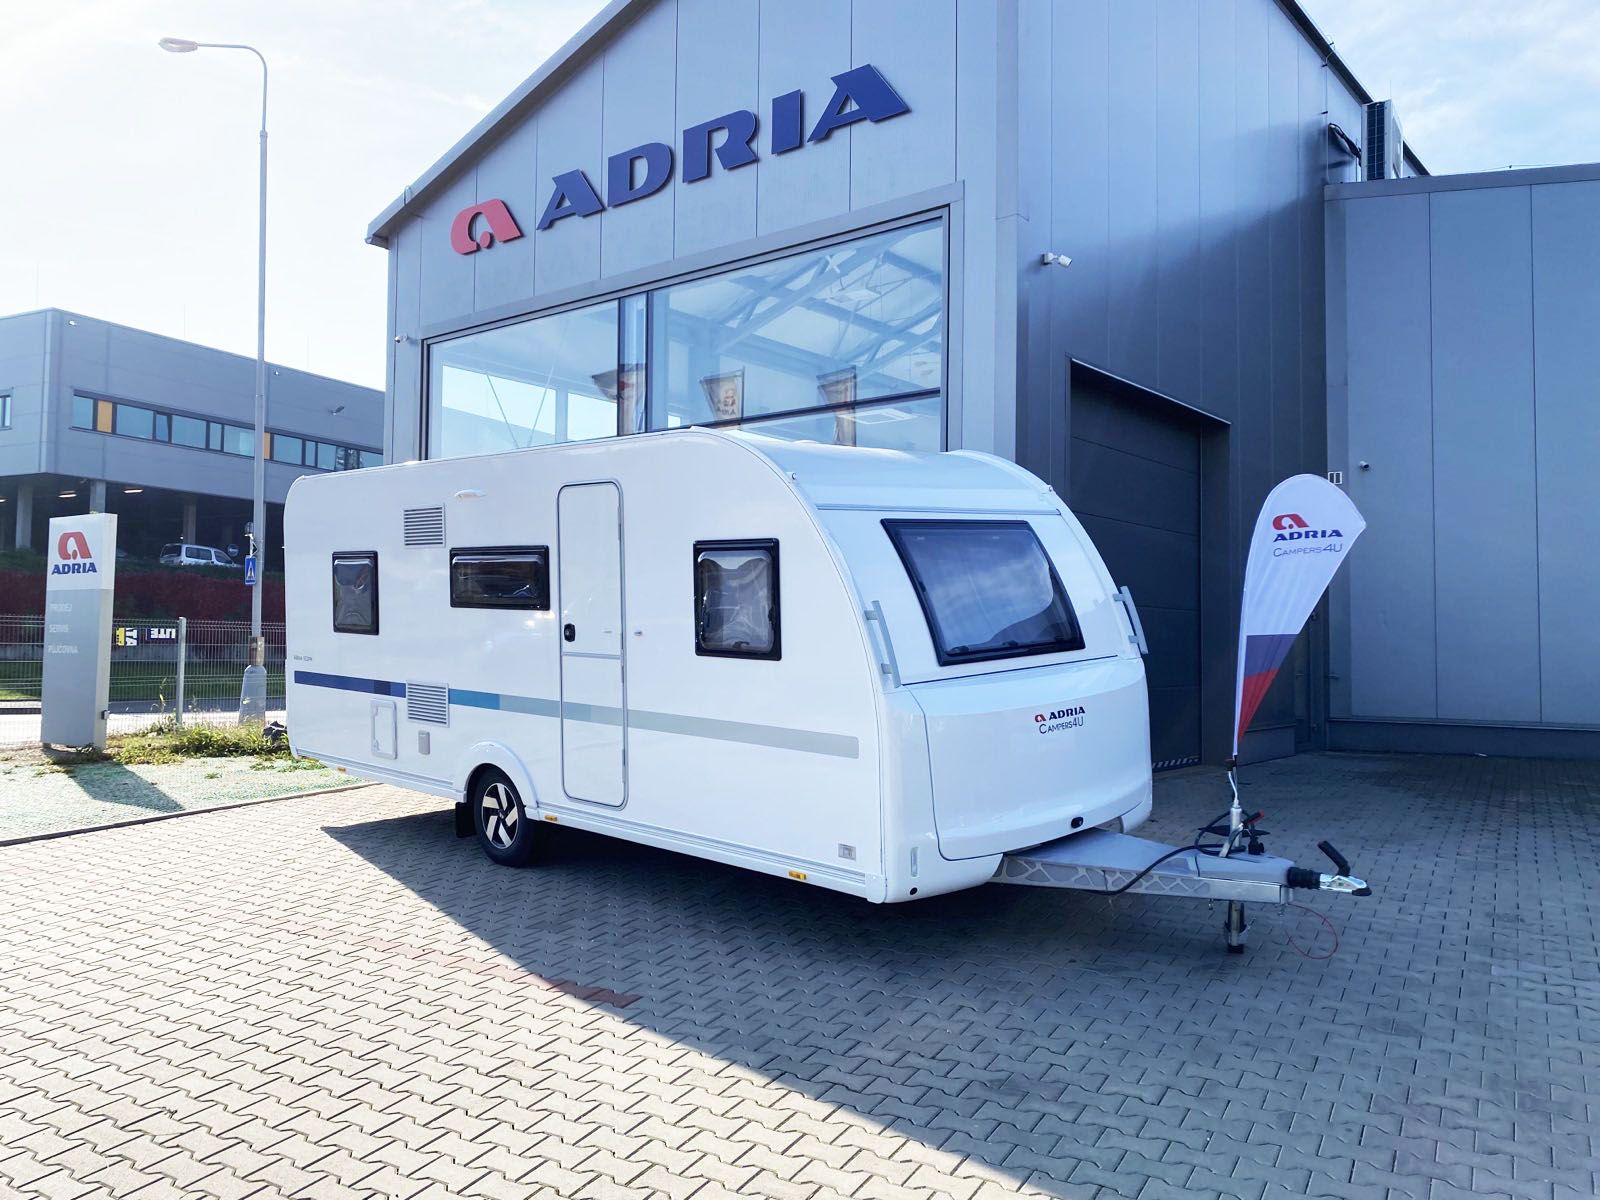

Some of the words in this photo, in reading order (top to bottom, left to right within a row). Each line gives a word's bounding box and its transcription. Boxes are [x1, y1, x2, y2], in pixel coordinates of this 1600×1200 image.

[536, 64, 910, 231] ADRIA
[1273, 529, 1343, 542] ADRIA
[51, 562, 97, 575] ADRIA
[1049, 706, 1086, 720] ADRIA
